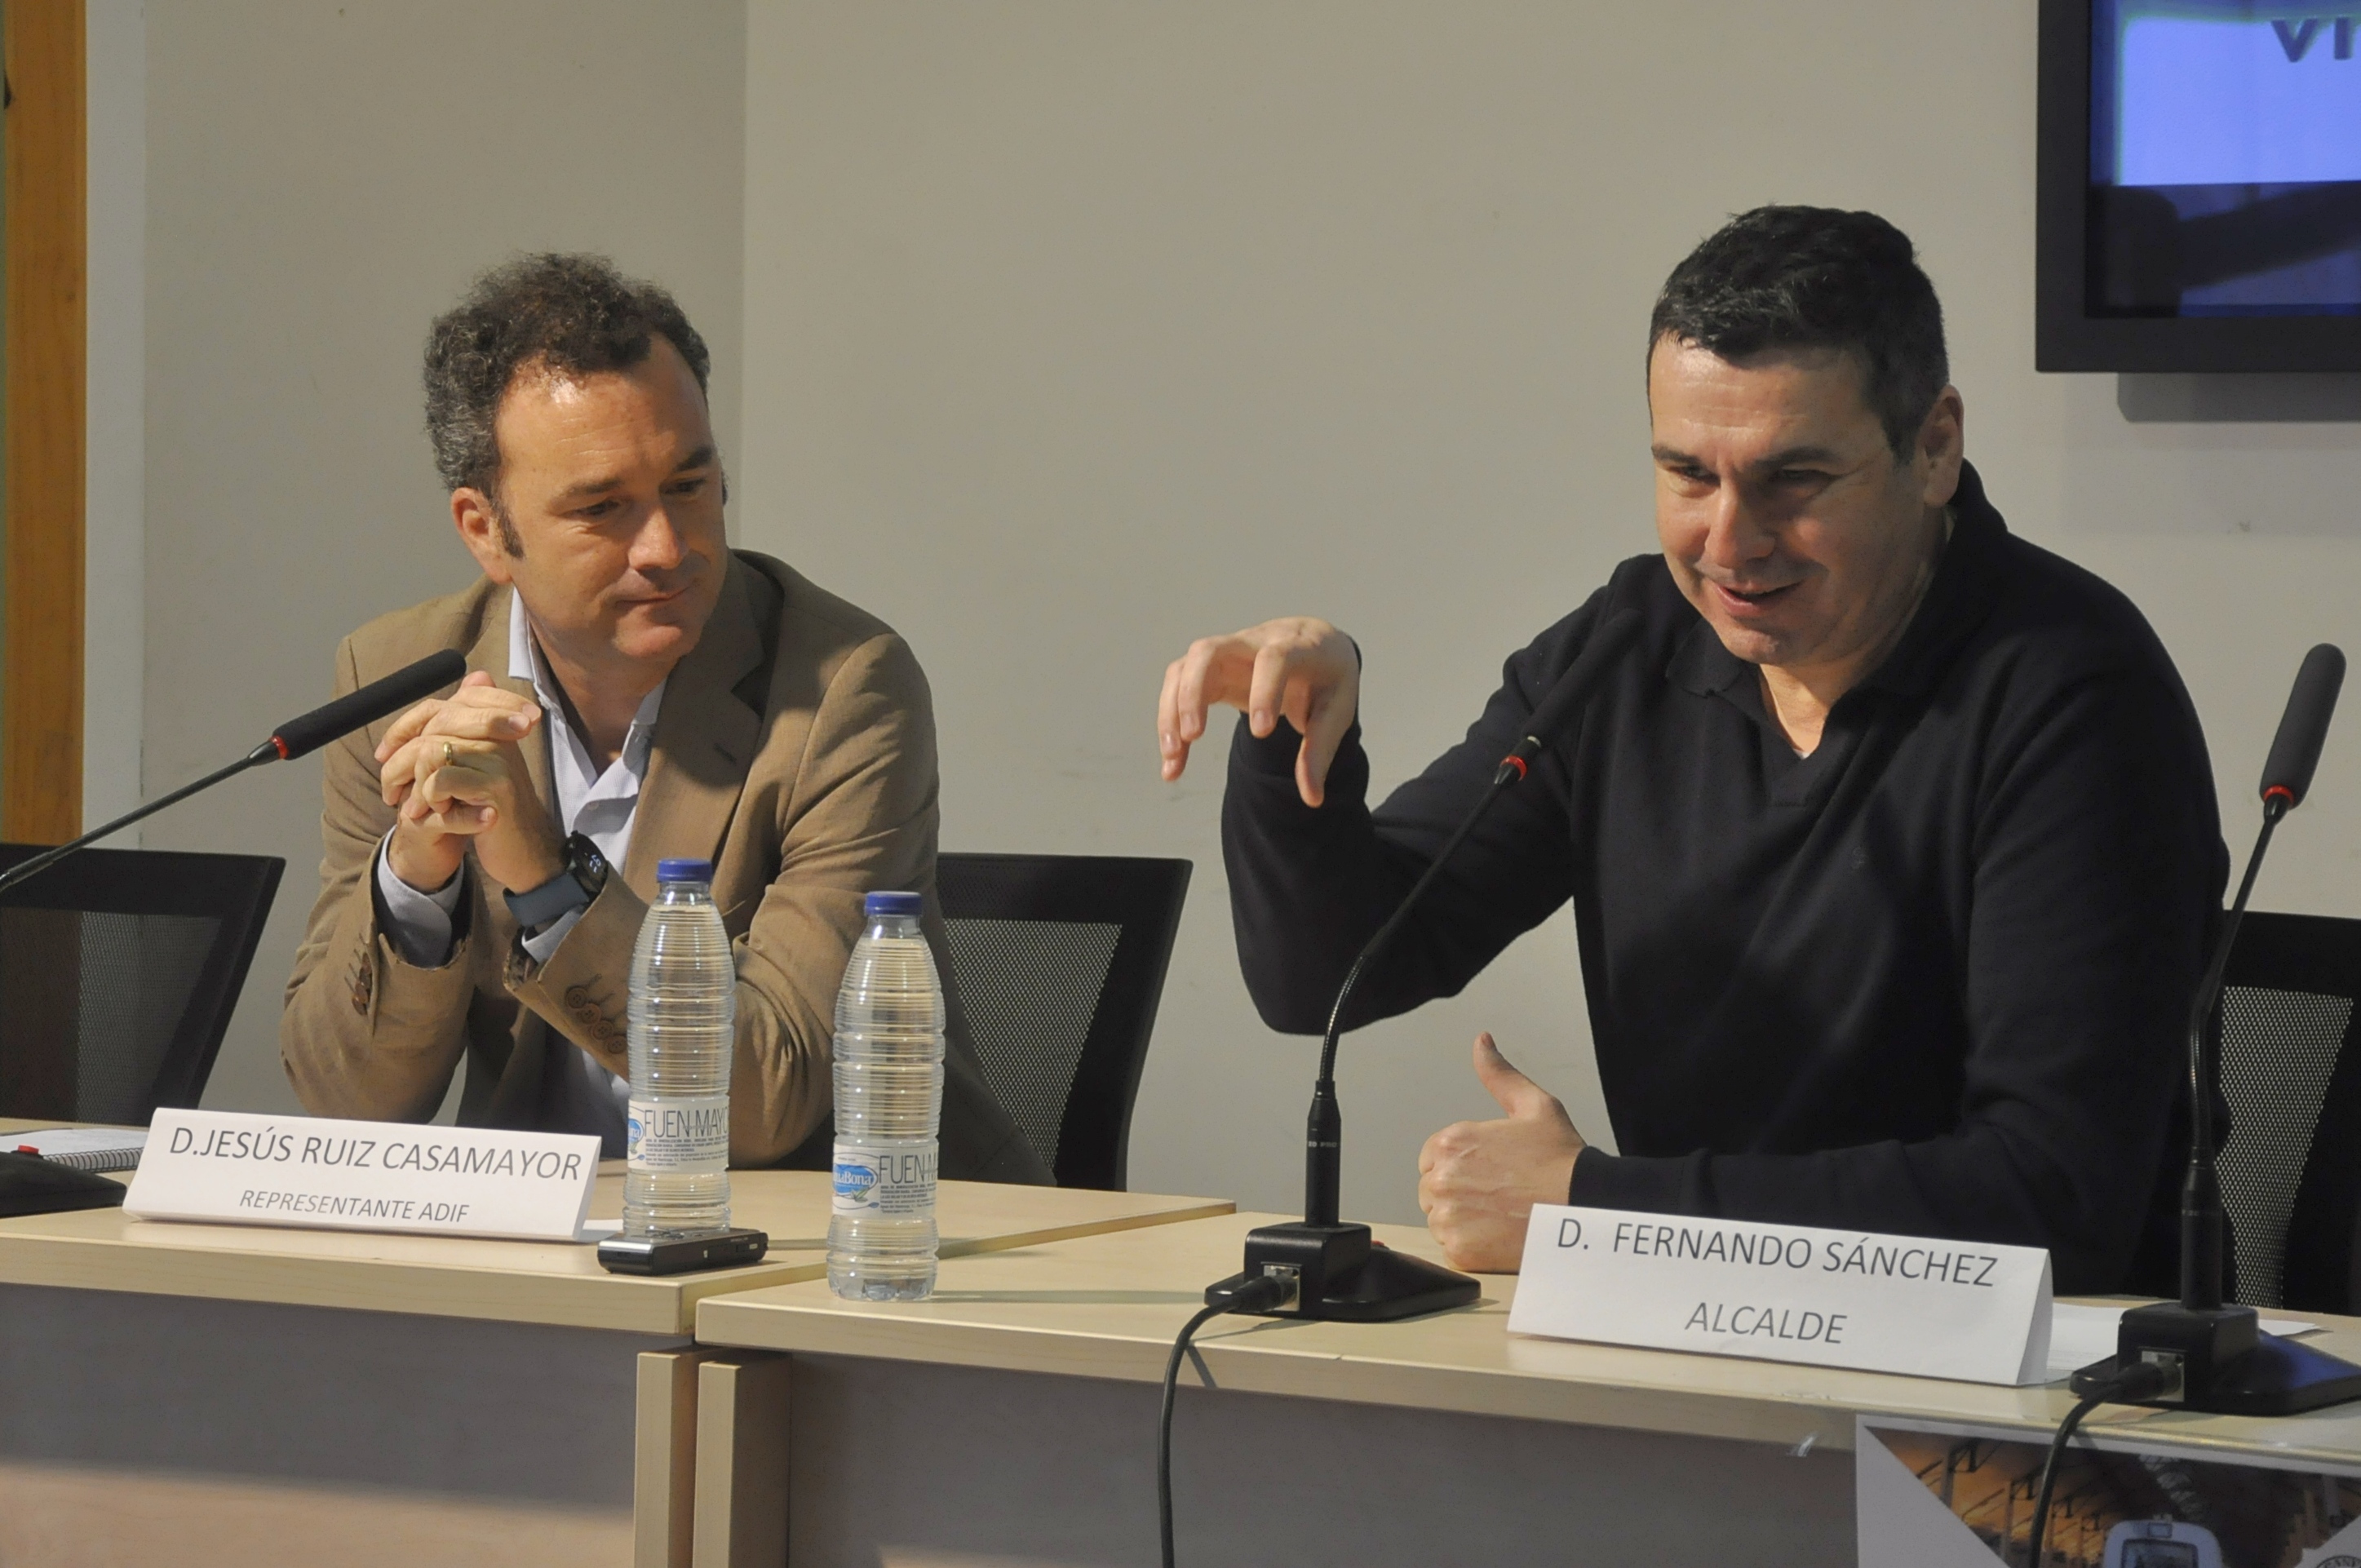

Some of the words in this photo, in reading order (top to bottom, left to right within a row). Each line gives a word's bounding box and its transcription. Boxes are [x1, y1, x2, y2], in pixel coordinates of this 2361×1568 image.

[169, 1125, 295, 1163] D.JESÚS
[300, 1136, 377, 1169] RUIZ
[382, 1142, 582, 1182] CASAMAYOR
[239, 1189, 417, 1220] REPRESENTANTE
[418, 1201, 470, 1223] ADIF
[1557, 1217, 1590, 1251] D.
[1613, 1222, 1813, 1270] FERNANDO
[1822, 1238, 1999, 1288] SÁNCHEZ
[1684, 1301, 1849, 1345] ALCALDE
